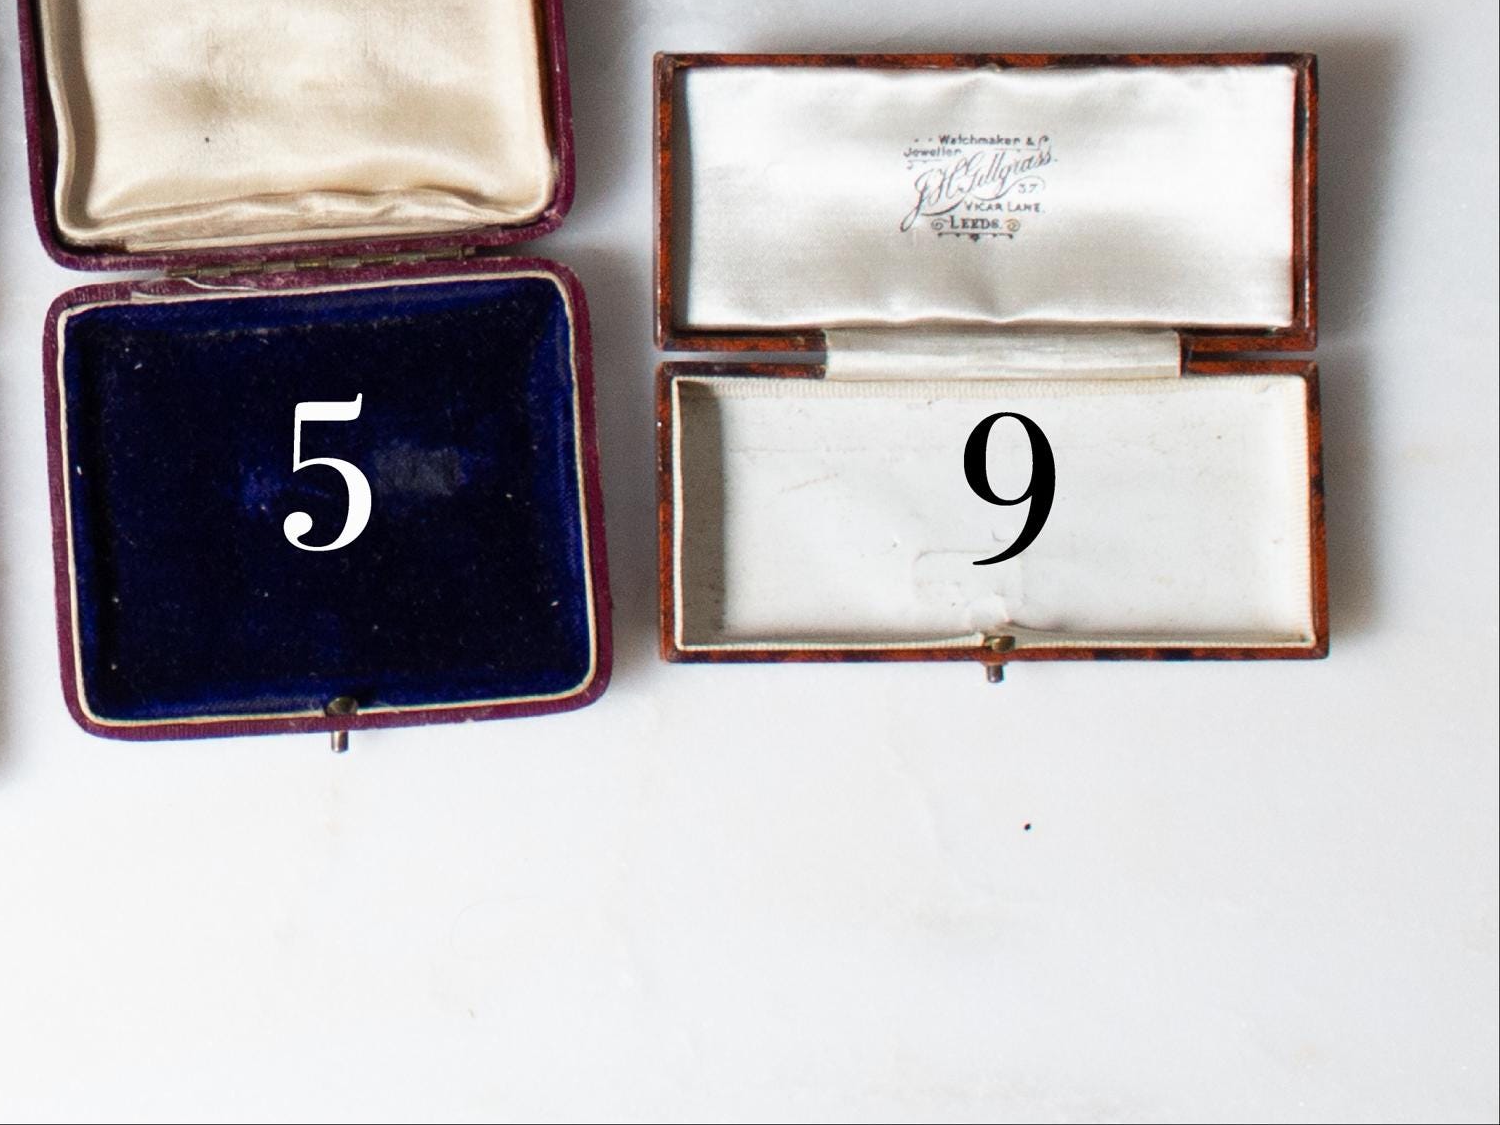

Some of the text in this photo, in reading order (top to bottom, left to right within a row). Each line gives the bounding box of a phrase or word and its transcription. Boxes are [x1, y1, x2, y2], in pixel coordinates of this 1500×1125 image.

[938, 134, 1036, 146] Watchmaker &
[903, 145, 963, 159] Jeweller
[963, 201, 1004, 212] VICAR
